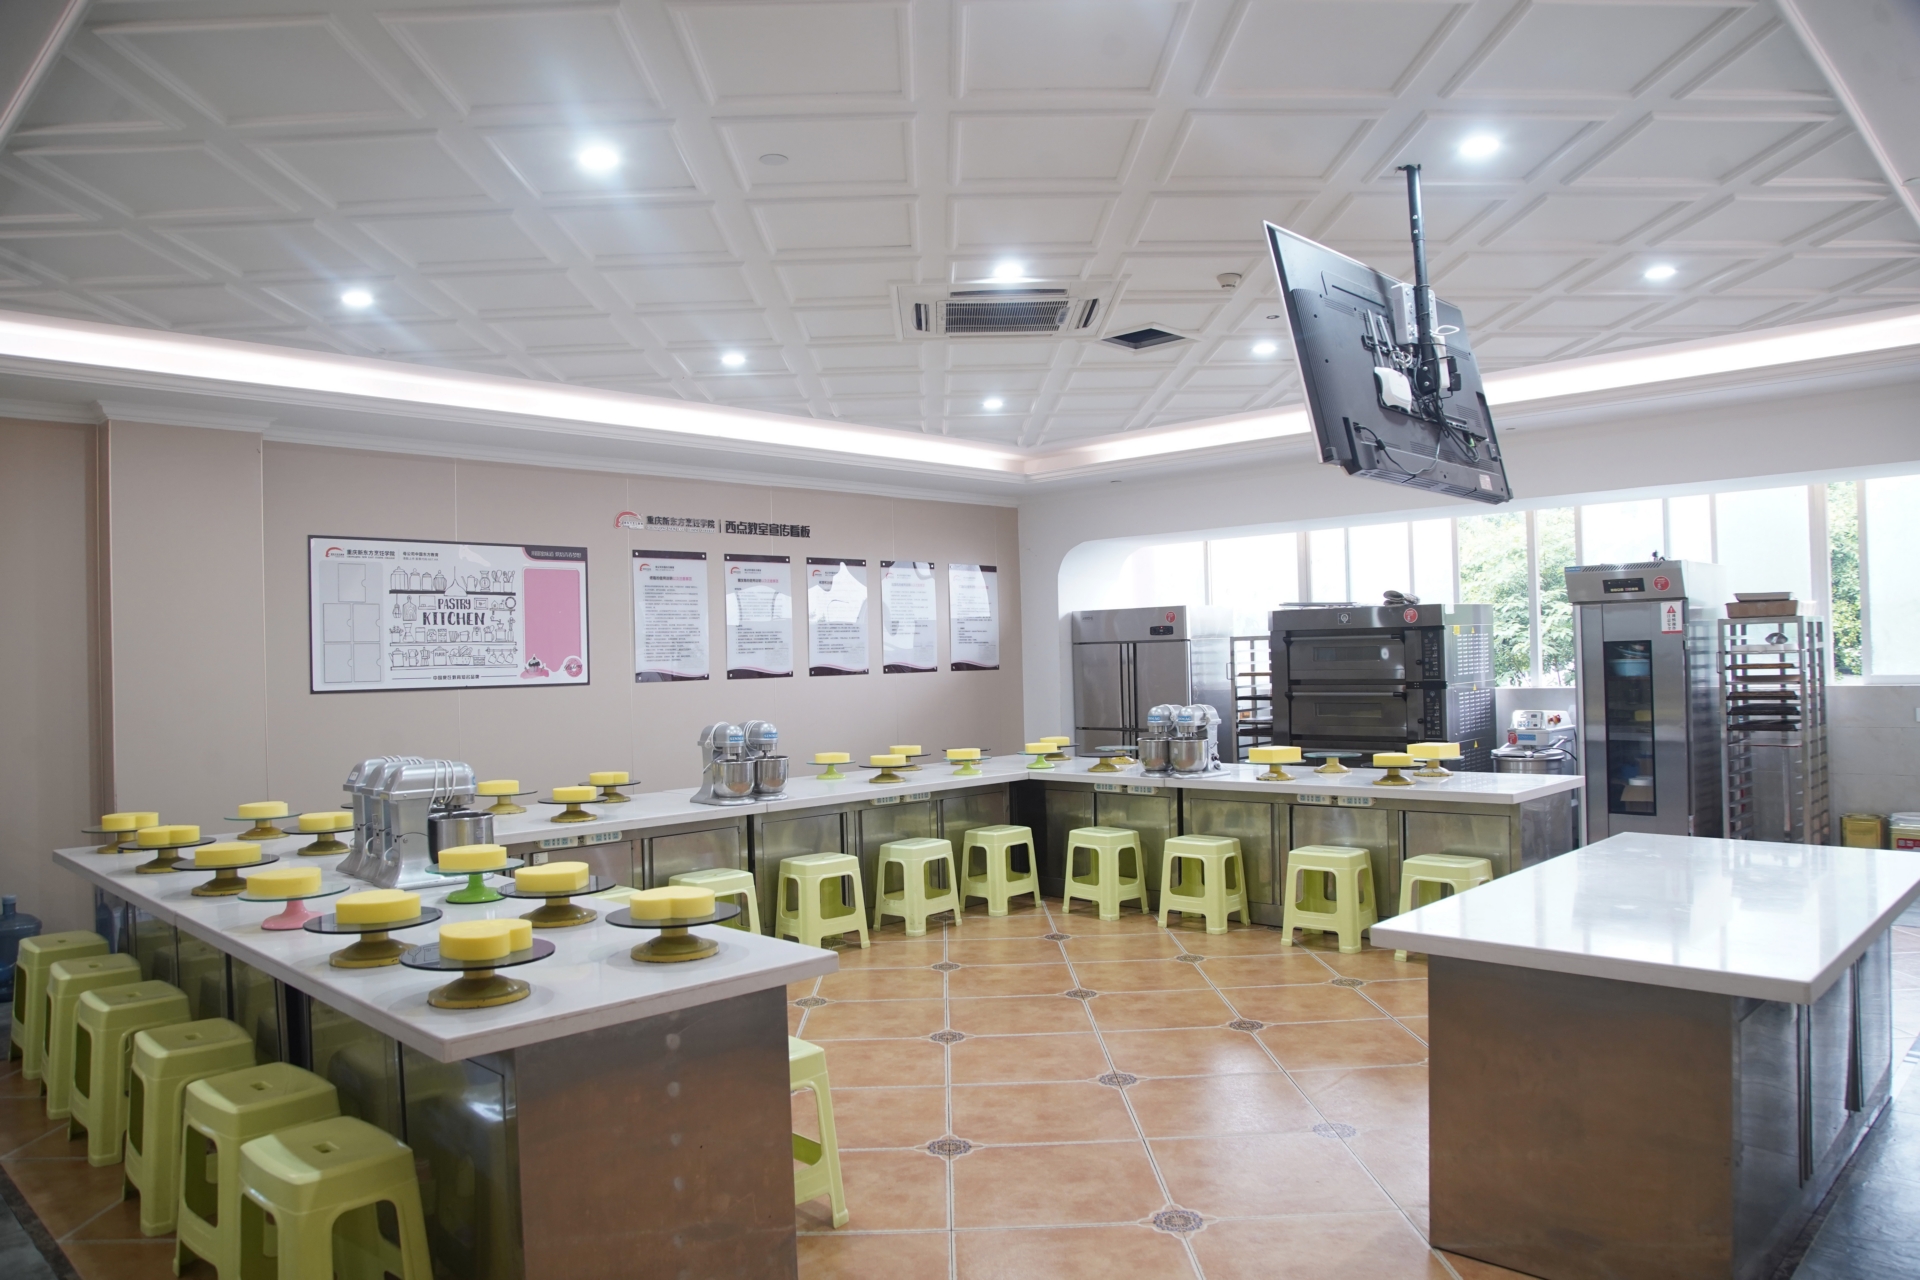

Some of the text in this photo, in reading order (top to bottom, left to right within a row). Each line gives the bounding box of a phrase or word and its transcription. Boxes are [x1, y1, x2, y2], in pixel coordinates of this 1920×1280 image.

[646, 515, 715, 529] 重庆新东方烹饪学院
[725, 520, 811, 538] 西点教室宣传看板
[437, 598, 471, 610] PASTRY
[422, 611, 485, 626] KITCHEN
